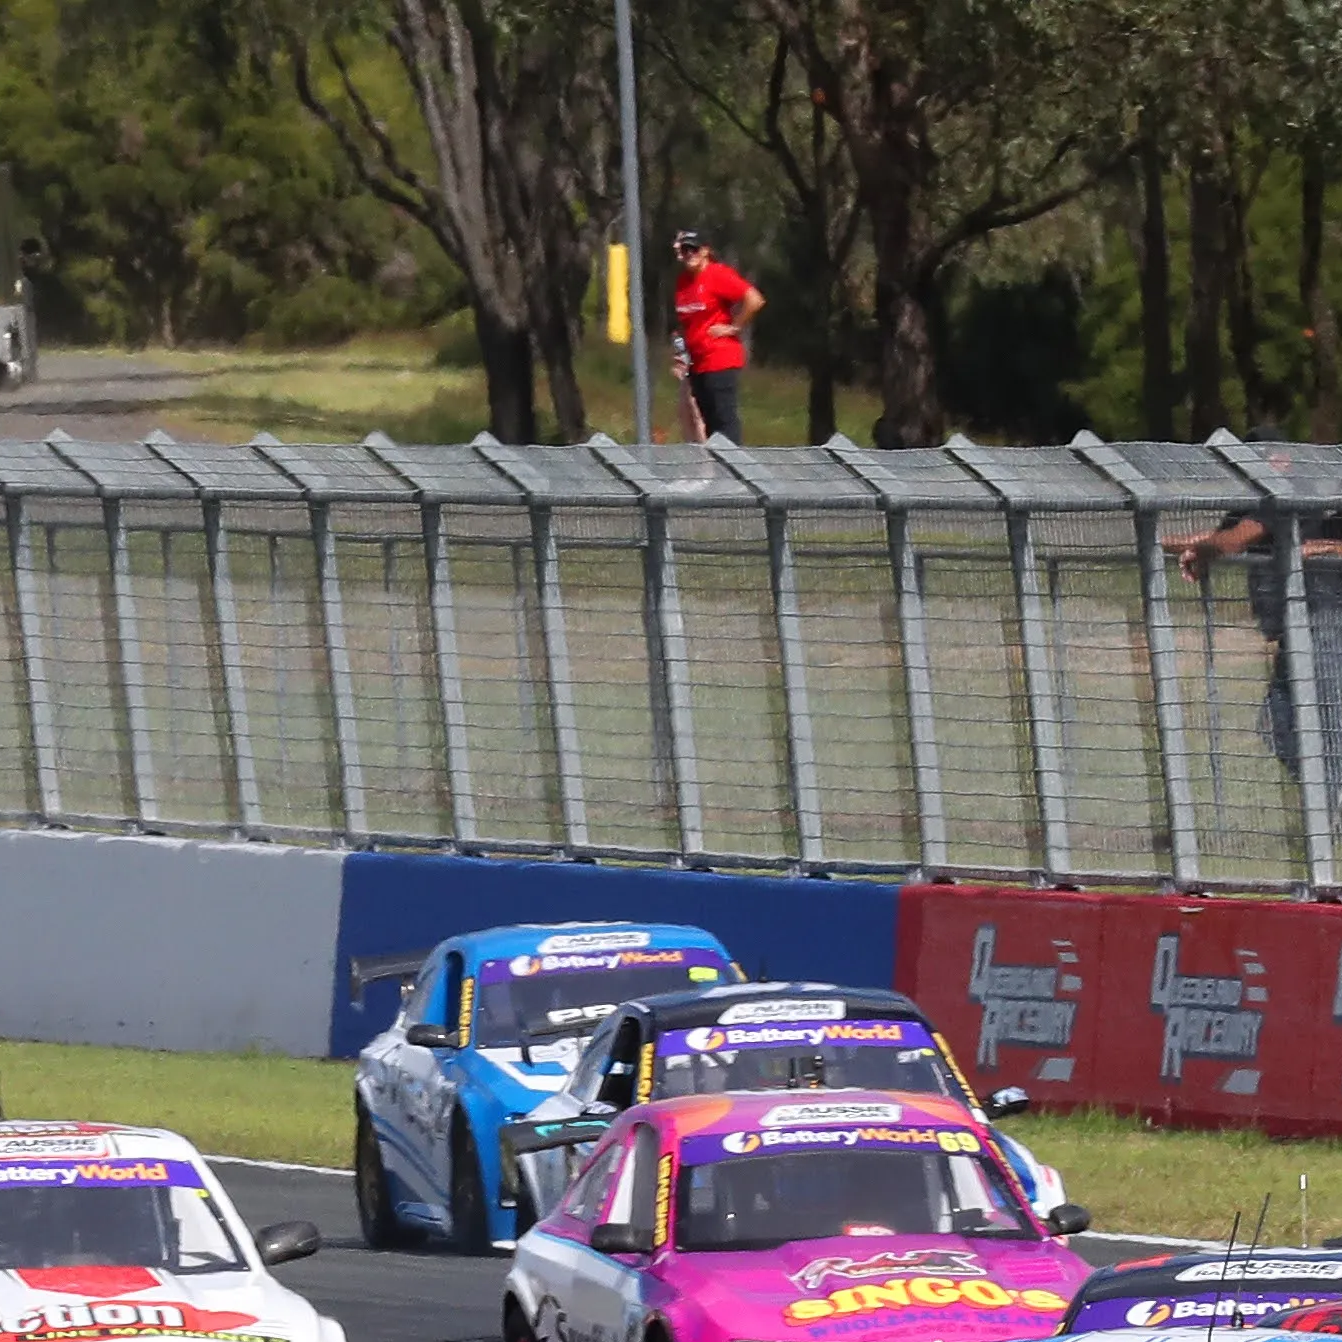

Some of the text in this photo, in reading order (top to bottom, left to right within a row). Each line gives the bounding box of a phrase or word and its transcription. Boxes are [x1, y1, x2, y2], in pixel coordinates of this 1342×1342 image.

[725, 1025, 902, 1045] BatteryWorld
[7, 1137, 97, 1146] AUSSIE
[762, 1129, 981, 1152] BatteryWorld 69
[1224, 1261, 1340, 1271] AUSSIE
[782, 1276, 1069, 1327] SINGO'S
[26, 1329, 99, 1341] LINE
